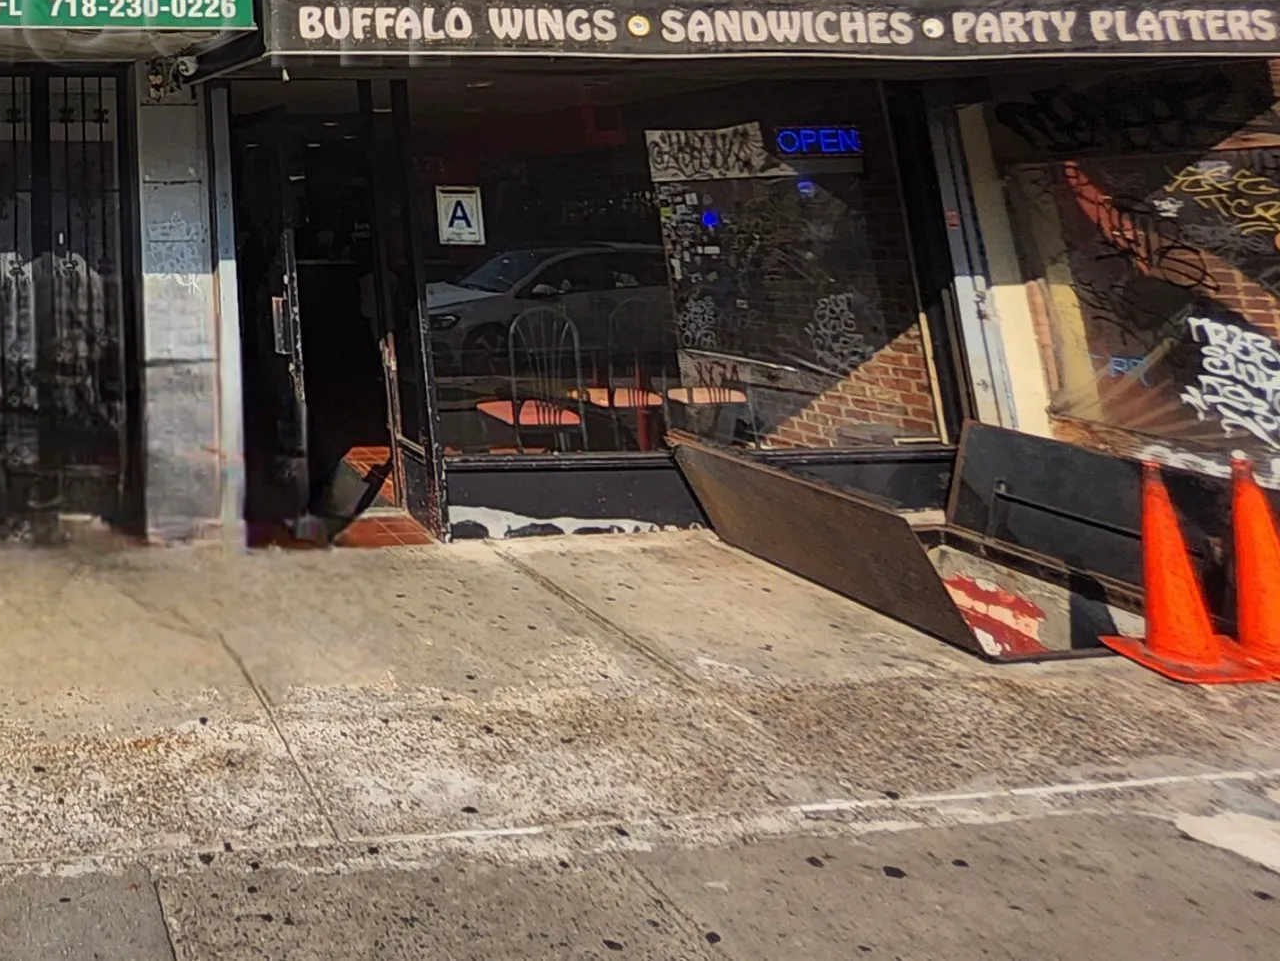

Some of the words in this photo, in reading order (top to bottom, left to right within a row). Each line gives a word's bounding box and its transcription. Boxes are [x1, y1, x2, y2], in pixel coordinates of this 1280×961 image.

[298, 6, 474, 40] BUFFALO
[487, 7, 618, 41] WINGS
[661, 9, 914, 44] SANDWICHES
[951, 9, 1078, 45] PARTY
[1090, 9, 1278, 42] PLATTERS
[776, 129, 861, 154] OPEN
[447, 199, 473, 229] A
